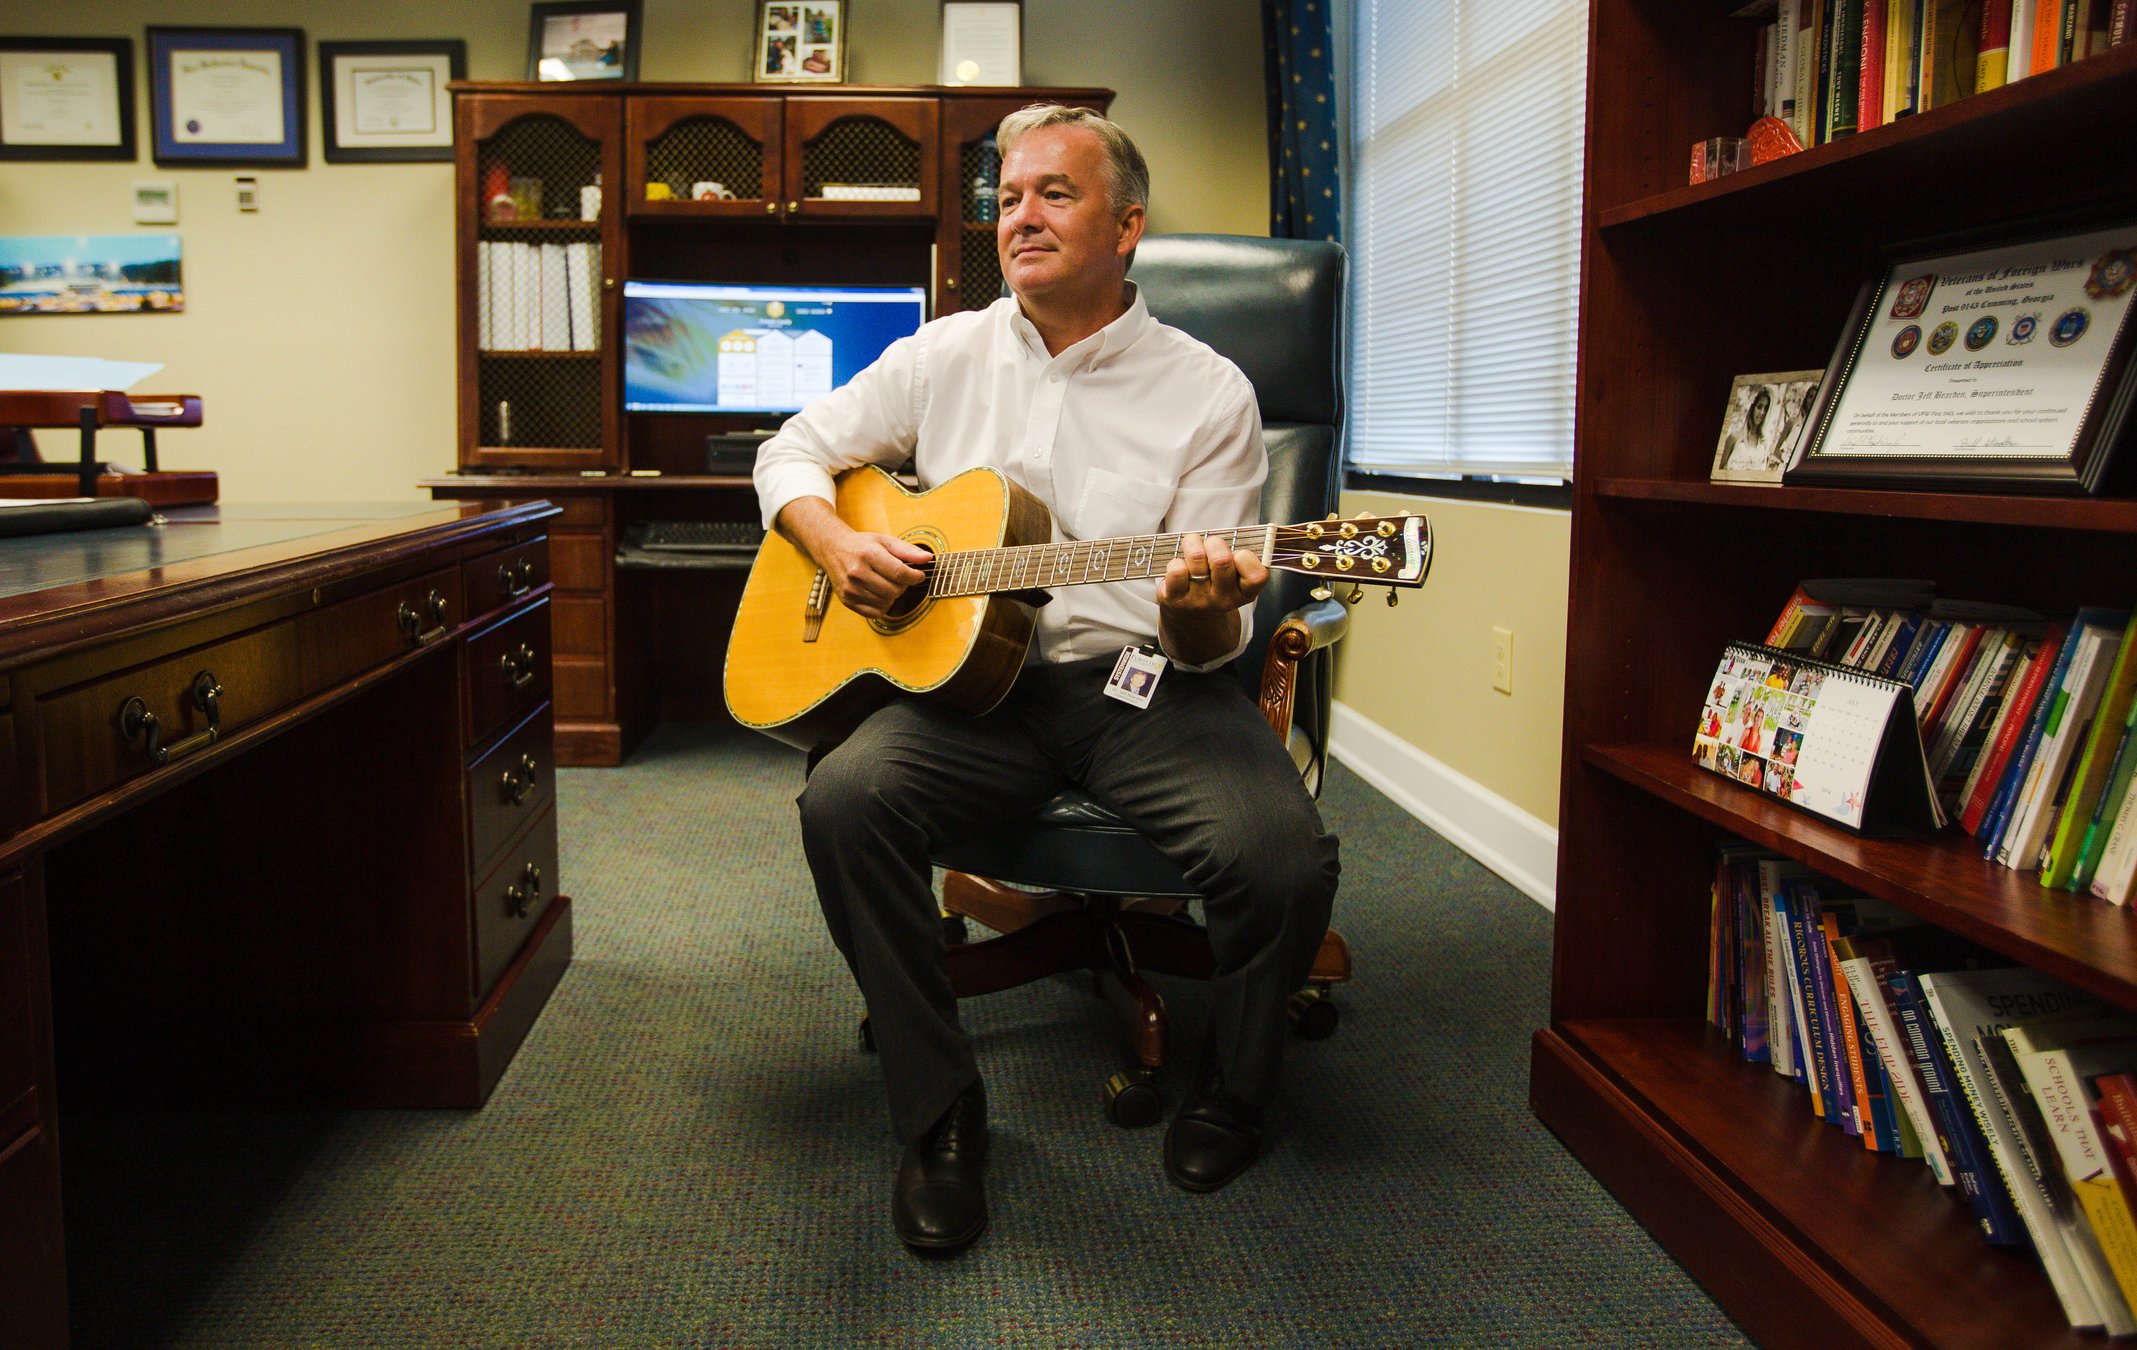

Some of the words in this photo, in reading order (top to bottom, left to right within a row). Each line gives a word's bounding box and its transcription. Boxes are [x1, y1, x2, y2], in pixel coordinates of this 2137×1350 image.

[2064, 3, 2075, 40] MARZANO
[2110, 2, 2127, 48] CATMULL
[1779, 10, 1788, 67] FRIEDMAN
[1859, 12, 1869, 70] LENCIONI
[1941, 274, 1984, 287] Veterans
[1986, 270, 1998, 281] of
[1999, 264, 2047, 280] Foreign
[2050, 258, 2085, 271] Wars
[1984, 284, 2009, 294] United
[2009, 281, 2034, 291] States
[1960, 302, 1979, 311] 9143
[2021, 294, 2055, 304] Georgia
[1924, 363, 1962, 372] Certificate
[1963, 361, 1972, 370] of
[1972, 359, 2024, 370] Appreciation
[1891, 393, 1915, 401] Doctor
[1915, 391, 1933, 401] Jeff
[1970, 388, 2034, 398] Superintendent
[1776, 594, 1801, 631] Smarter
[1977, 666, 1998, 699] DISMISSAL
[1963, 696, 1982, 723] DOESN'T
[1955, 721, 1969, 739] HAVE
[2119, 791, 2136, 823] THOMAS
[2107, 831, 2121, 856] CRANE
[1762, 896, 1770, 926] BREAK
[1782, 938, 1792, 966] Leadership
[1848, 963, 1860, 983] FLIP
[1793, 920, 1809, 975] RIGOROUS
[1803, 975, 1822, 1049] CURRICULUM
[1816, 1050, 1829, 1091] DESIGN
[1900, 1007, 1916, 1023] on
[1828, 1031, 1838, 1058] Hidden
[1839, 992, 1854, 1043] ENGAGING
[1848, 1043, 1863, 1094] STUDENTS
[1860, 998, 1880, 1033] THE
[1876, 1034, 1895, 1069] FLIP
[1889, 1068, 1913, 1106] SIDE
[1905, 1020, 1930, 1062] common
[1916, 1056, 1946, 1099] ground
[1942, 1025, 1967, 1074] SPENDING
[1963, 1073, 1982, 1108] MONEY
[1978, 1109, 1998, 1147] WISELY
[2041, 1086, 2068, 1134] LEARN
[2046, 1057, 2080, 1123] SCHOOLS
[2076, 1126, 2095, 1161] THAT
